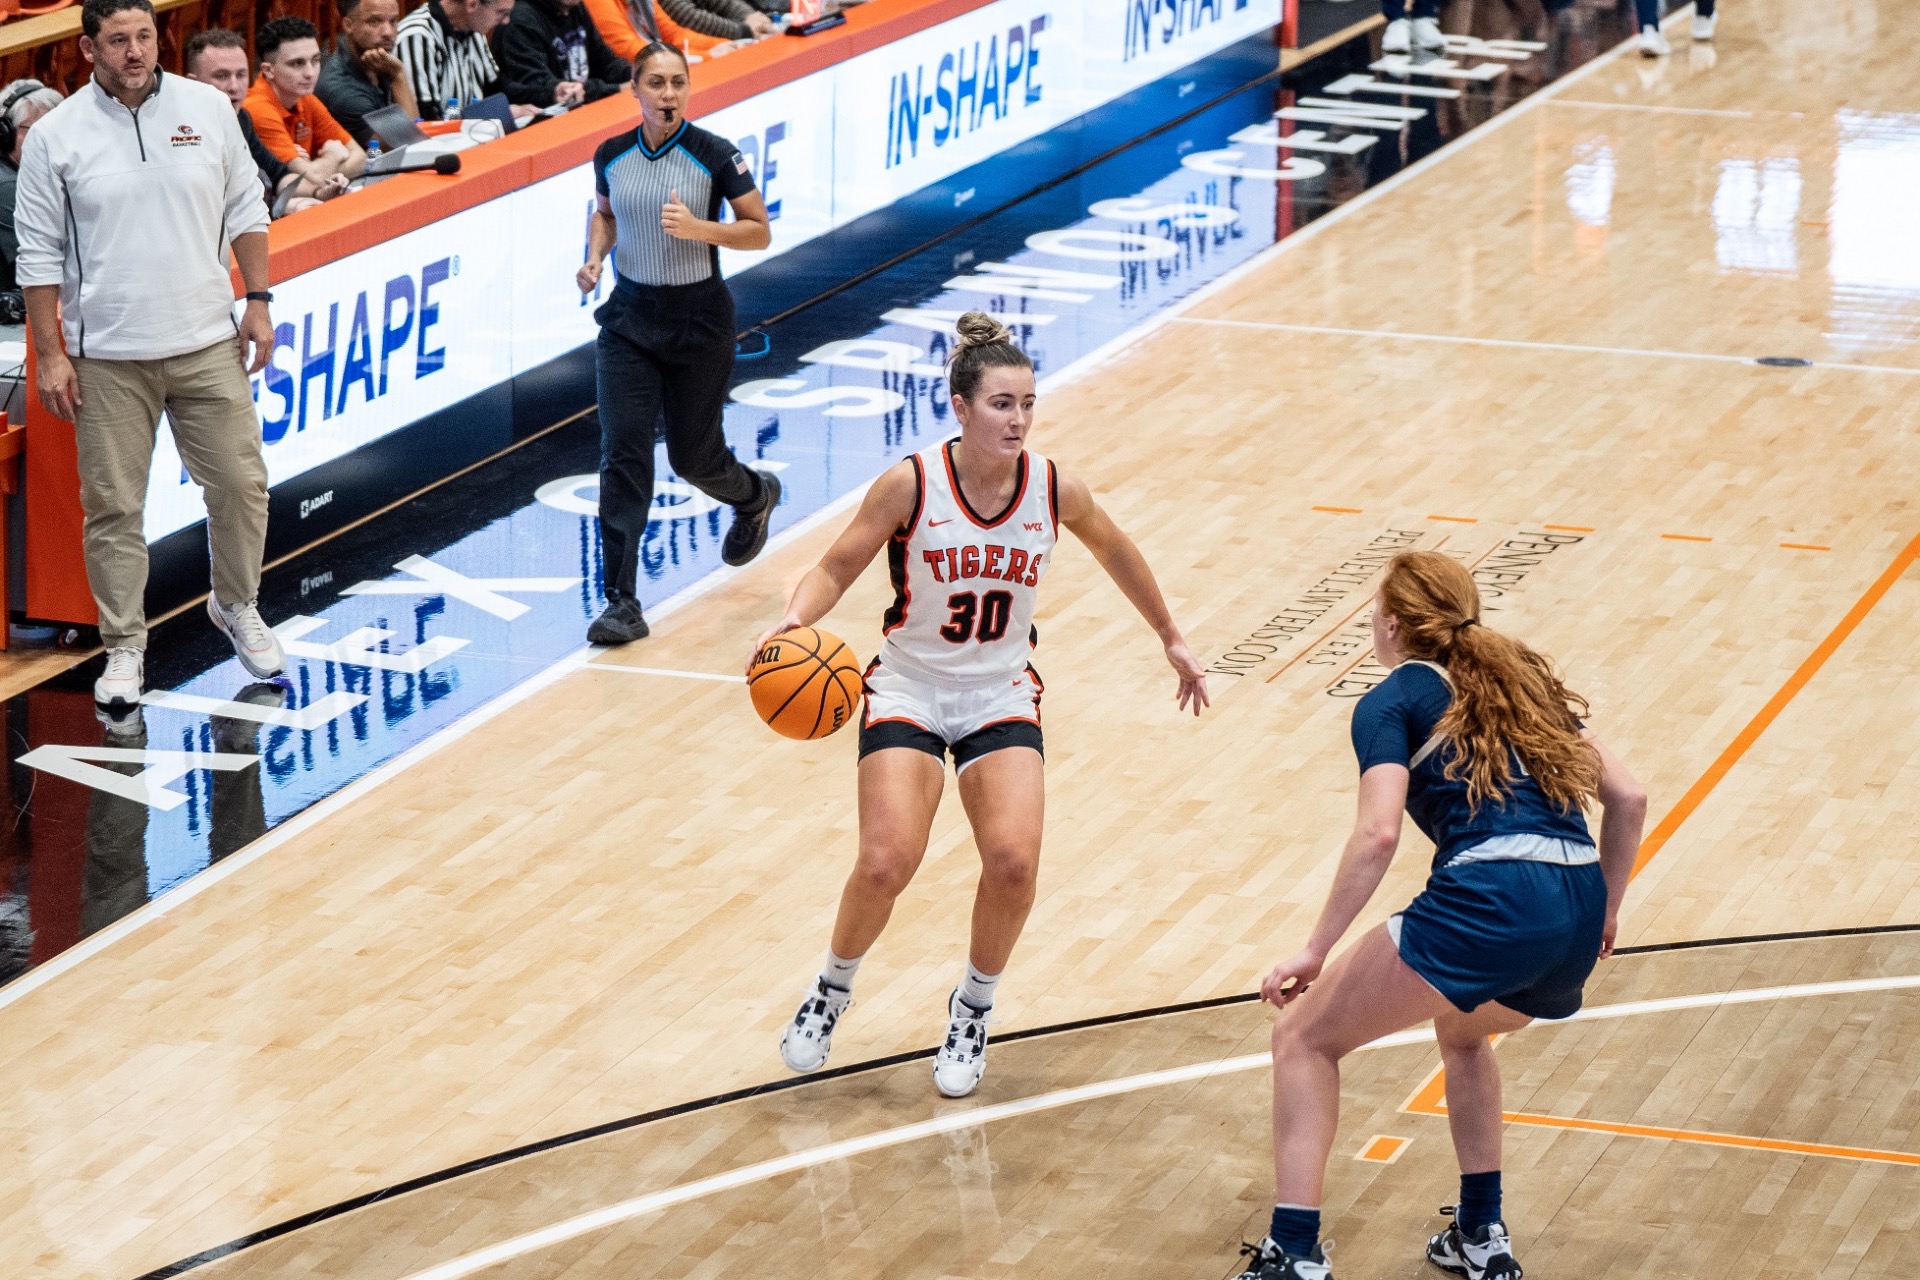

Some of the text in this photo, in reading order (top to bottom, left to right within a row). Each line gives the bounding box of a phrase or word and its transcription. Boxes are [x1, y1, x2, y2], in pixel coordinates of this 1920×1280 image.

[885, 14, 1046, 170] IN-SHAPE
[309, 490, 334, 511] ADART
[923, 544, 1043, 587] TIGERS
[1203, 528, 1425, 677] PENNEYLAWYERS.COM
[940, 590, 1014, 644] 30
[15, 553, 585, 811] ALEX
